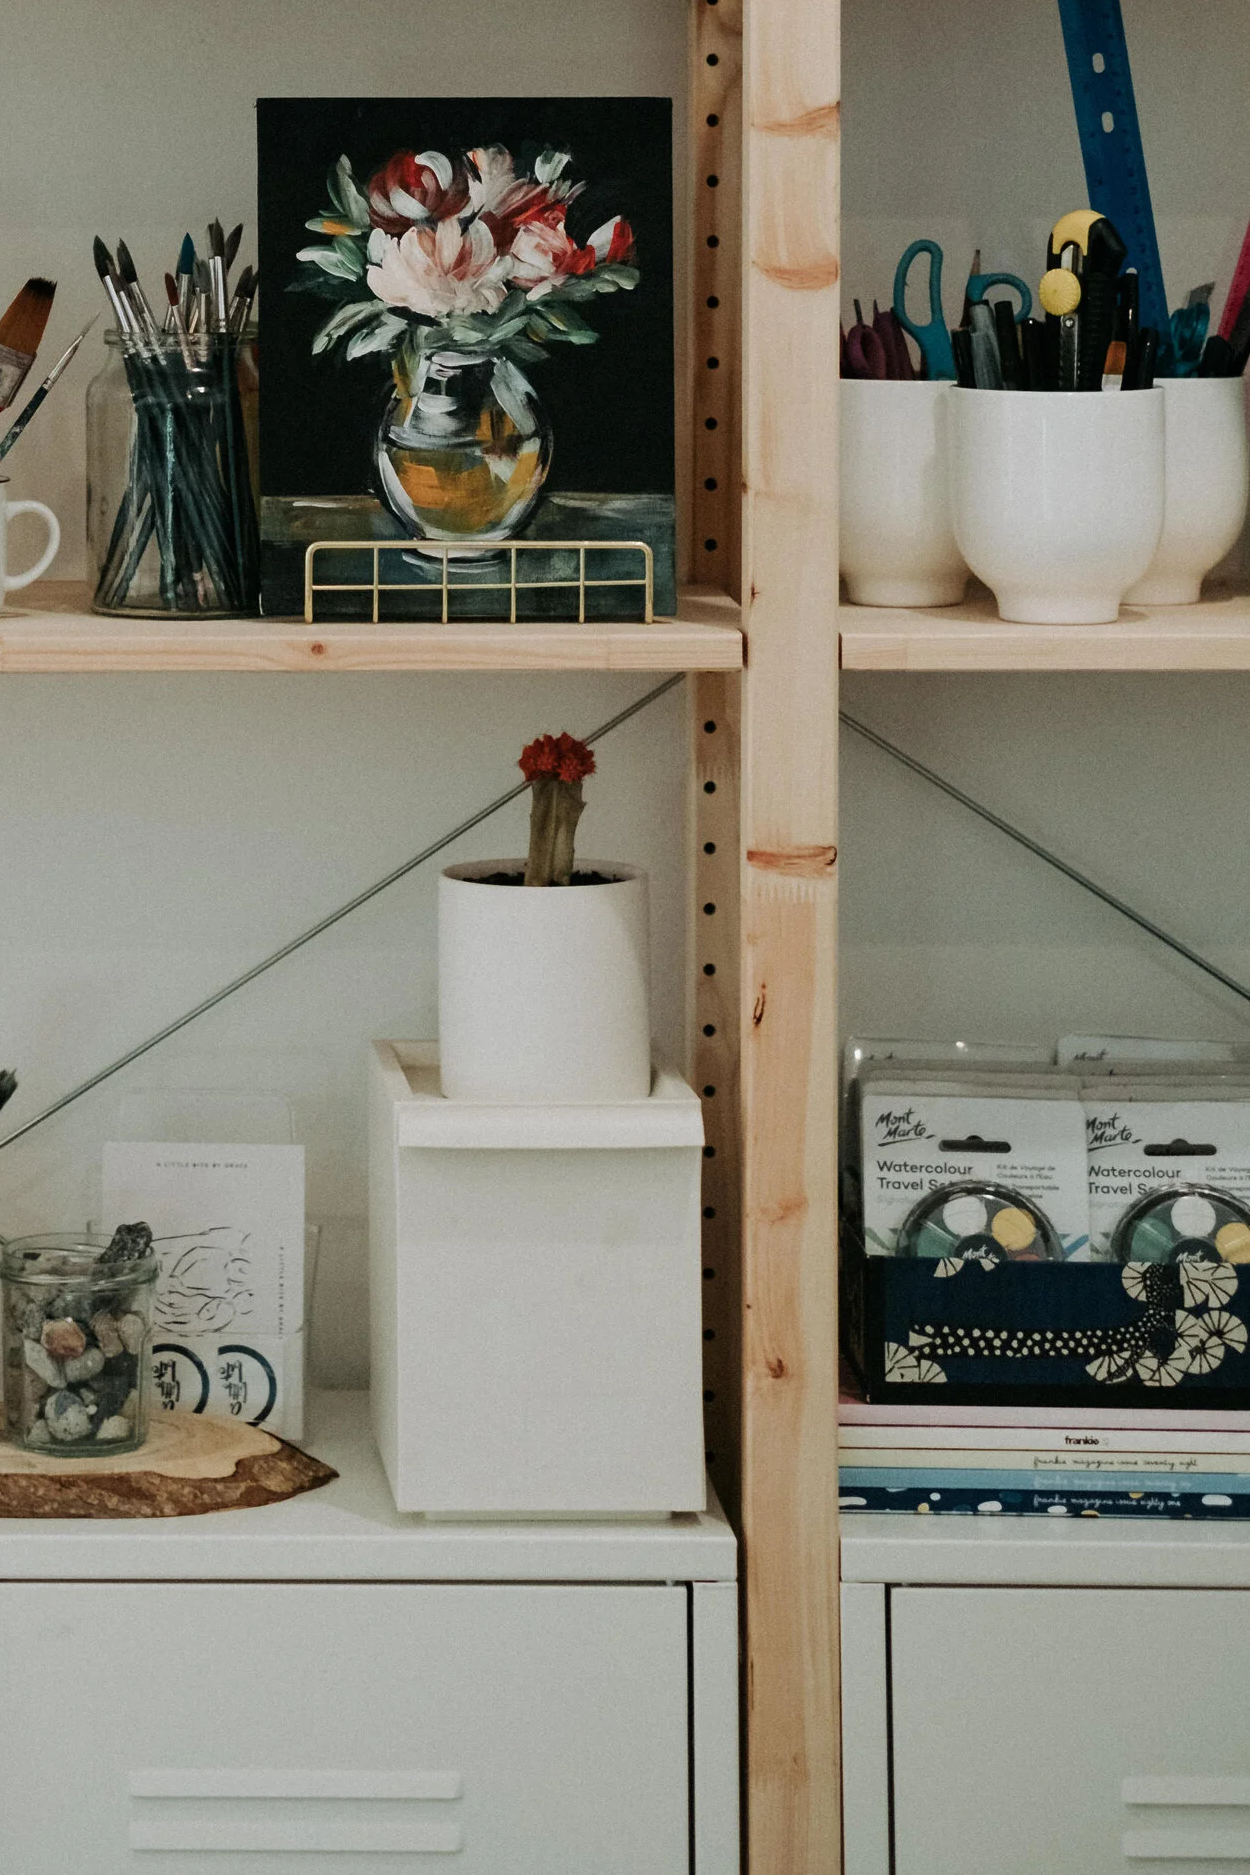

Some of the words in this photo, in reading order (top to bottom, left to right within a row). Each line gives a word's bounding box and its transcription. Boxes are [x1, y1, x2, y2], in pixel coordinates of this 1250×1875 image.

[875, 1107, 915, 1128] Mont
[1086, 1113, 1120, 1131] Mont
[883, 1120, 927, 1140] Marte
[1089, 1125, 1133, 1145] Marte
[877, 1160, 974, 1175] Watercolour
[1089, 1166, 1181, 1179] Watercolour
[877, 1177, 924, 1191] Travel
[928, 1179, 948, 1190] Se
[1088, 1183, 1132, 1195] Travel
[1065, 1435, 1099, 1445] frankie
[1033, 1456, 1067, 1468] frankie
[1072, 1459, 1114, 1469] magazine
[1033, 1493, 1067, 1508] frankie
[1070, 1498, 1113, 1509] magazine
